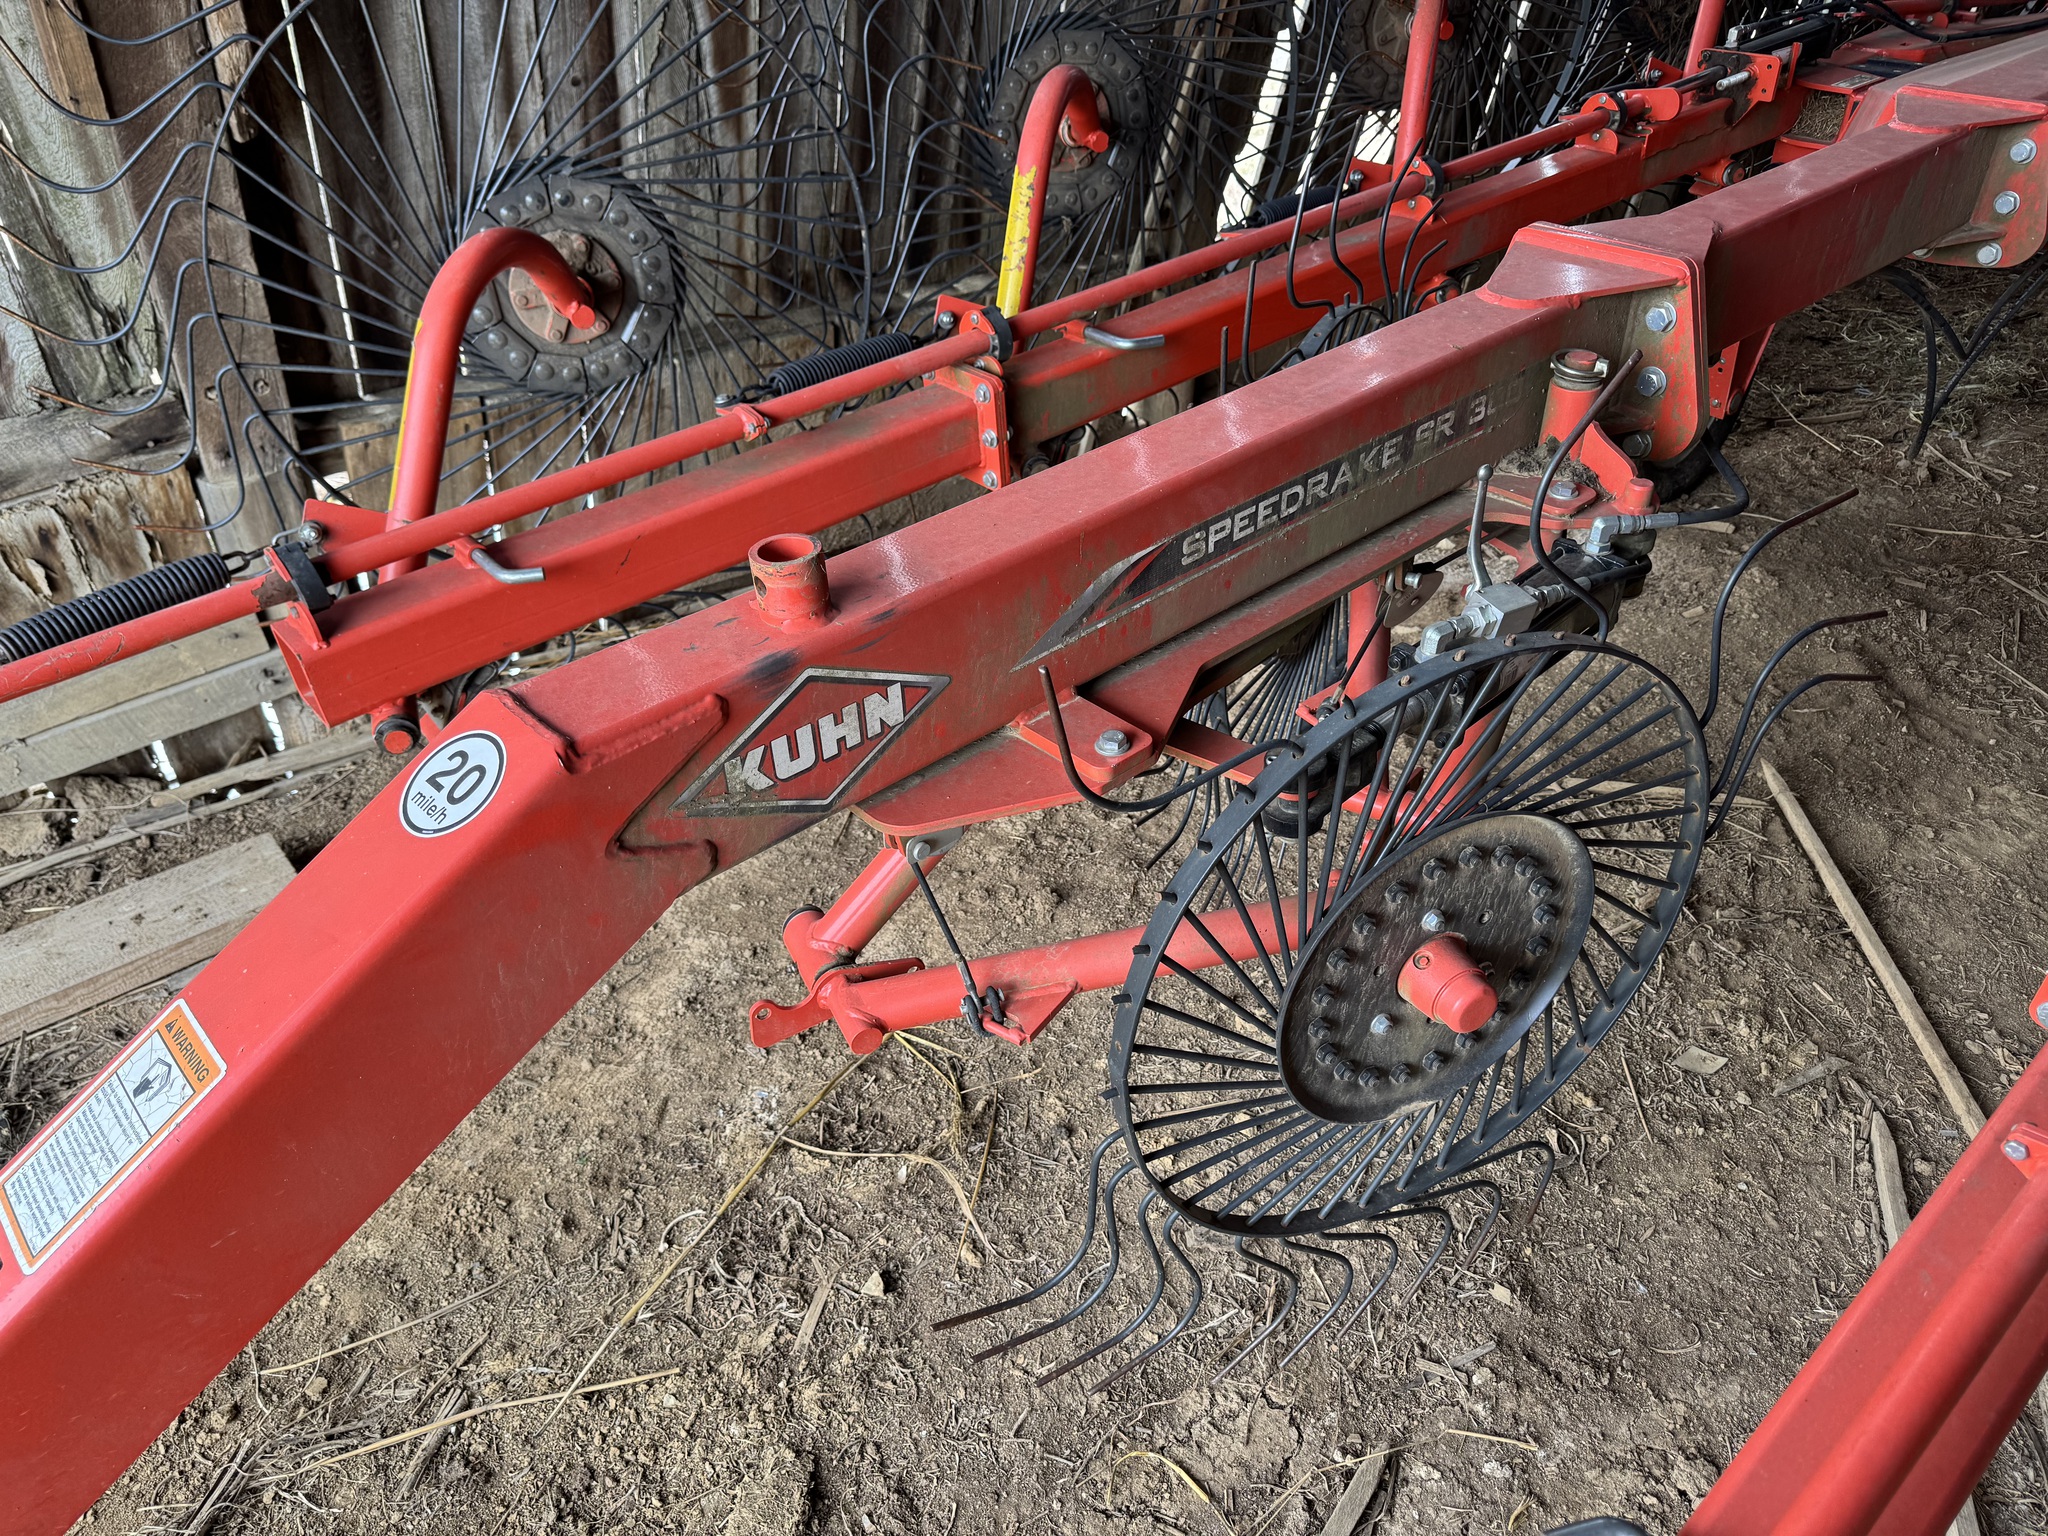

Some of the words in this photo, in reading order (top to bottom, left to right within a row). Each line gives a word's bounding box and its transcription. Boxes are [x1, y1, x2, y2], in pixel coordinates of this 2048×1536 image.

[1181, 435, 1404, 566] SPEEDRAKE
[1415, 411, 1455, 447] SR
[723, 682, 905, 796] KUHN
[425, 750, 487, 805] 20
[411, 791, 447, 825] mile/h
[172, 1026, 210, 1083] WARNING
